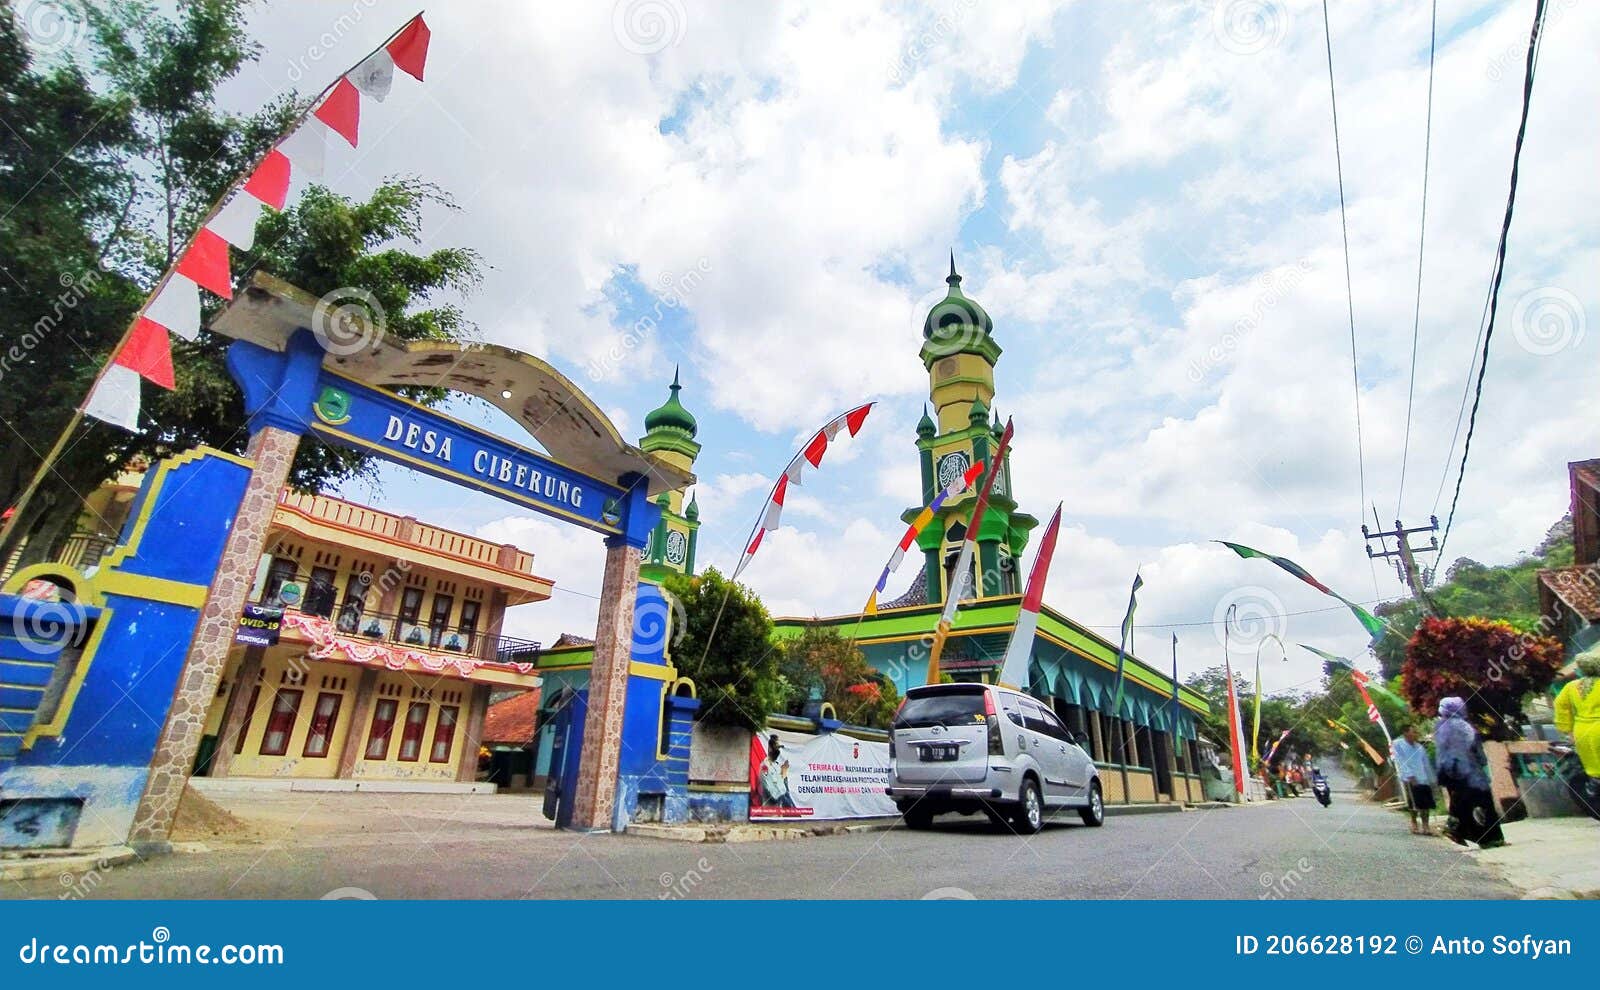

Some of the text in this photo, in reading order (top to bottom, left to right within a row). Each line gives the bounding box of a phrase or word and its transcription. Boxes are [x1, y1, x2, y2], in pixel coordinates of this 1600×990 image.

[384, 415, 583, 508] DESA CIBERUNG
[240, 617, 279, 630] OVID-19
[808, 763, 831, 771] TERIMA
[800, 774, 820, 782] TELAH
[798, 785, 823, 794] DENGAN
